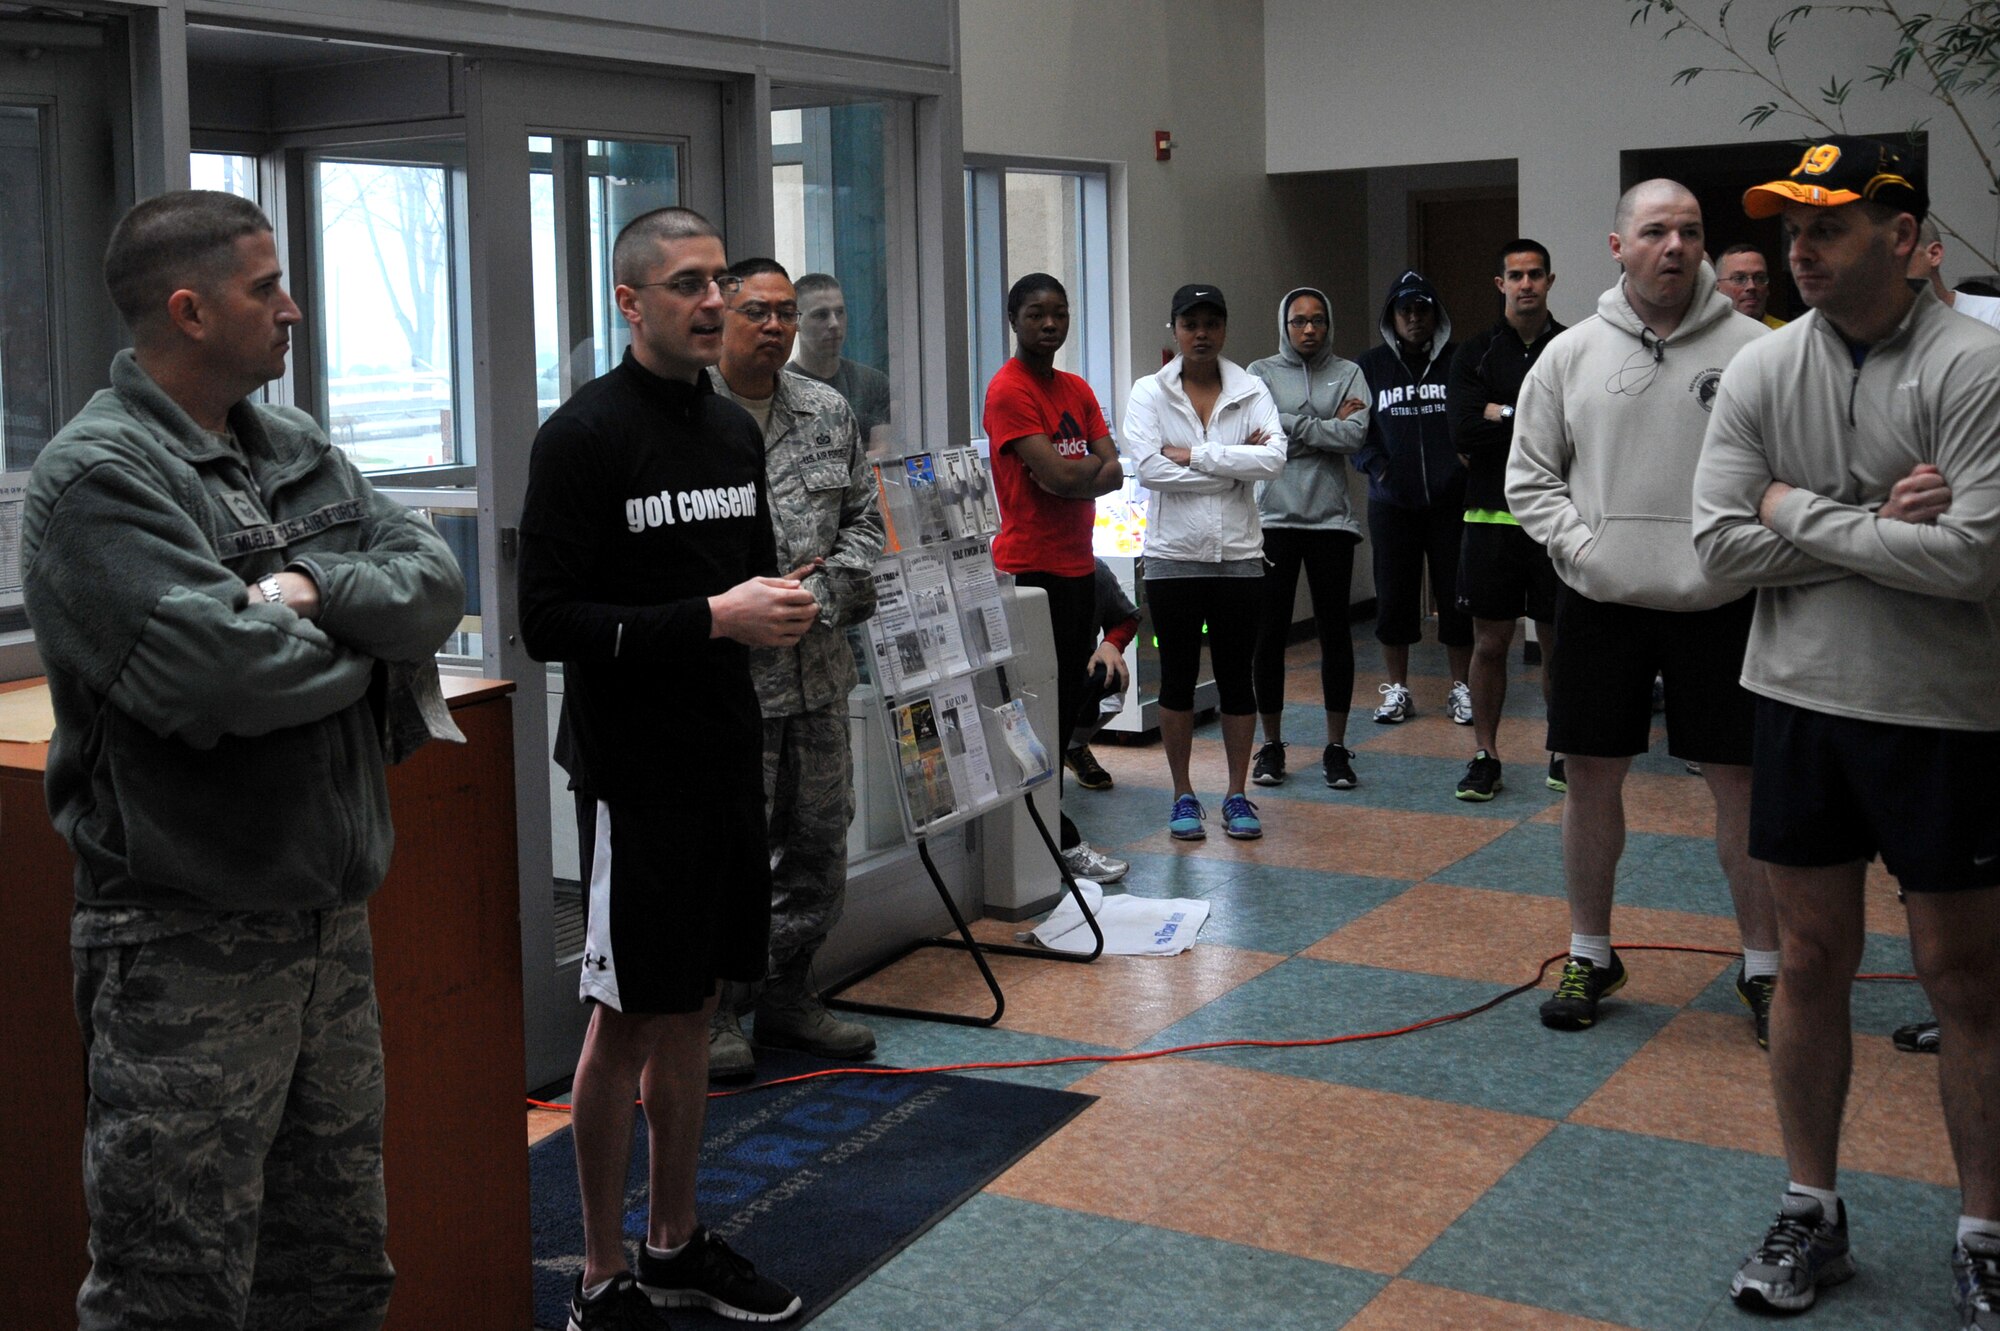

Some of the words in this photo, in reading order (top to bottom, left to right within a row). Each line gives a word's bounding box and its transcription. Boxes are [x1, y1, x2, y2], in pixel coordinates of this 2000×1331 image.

[1378, 386, 1403, 412] AIR
[1405, 383, 1447, 401] FORC
[302, 515, 325, 534] AIR
[323, 501, 365, 524] FORCE
[625, 490, 676, 533] got
